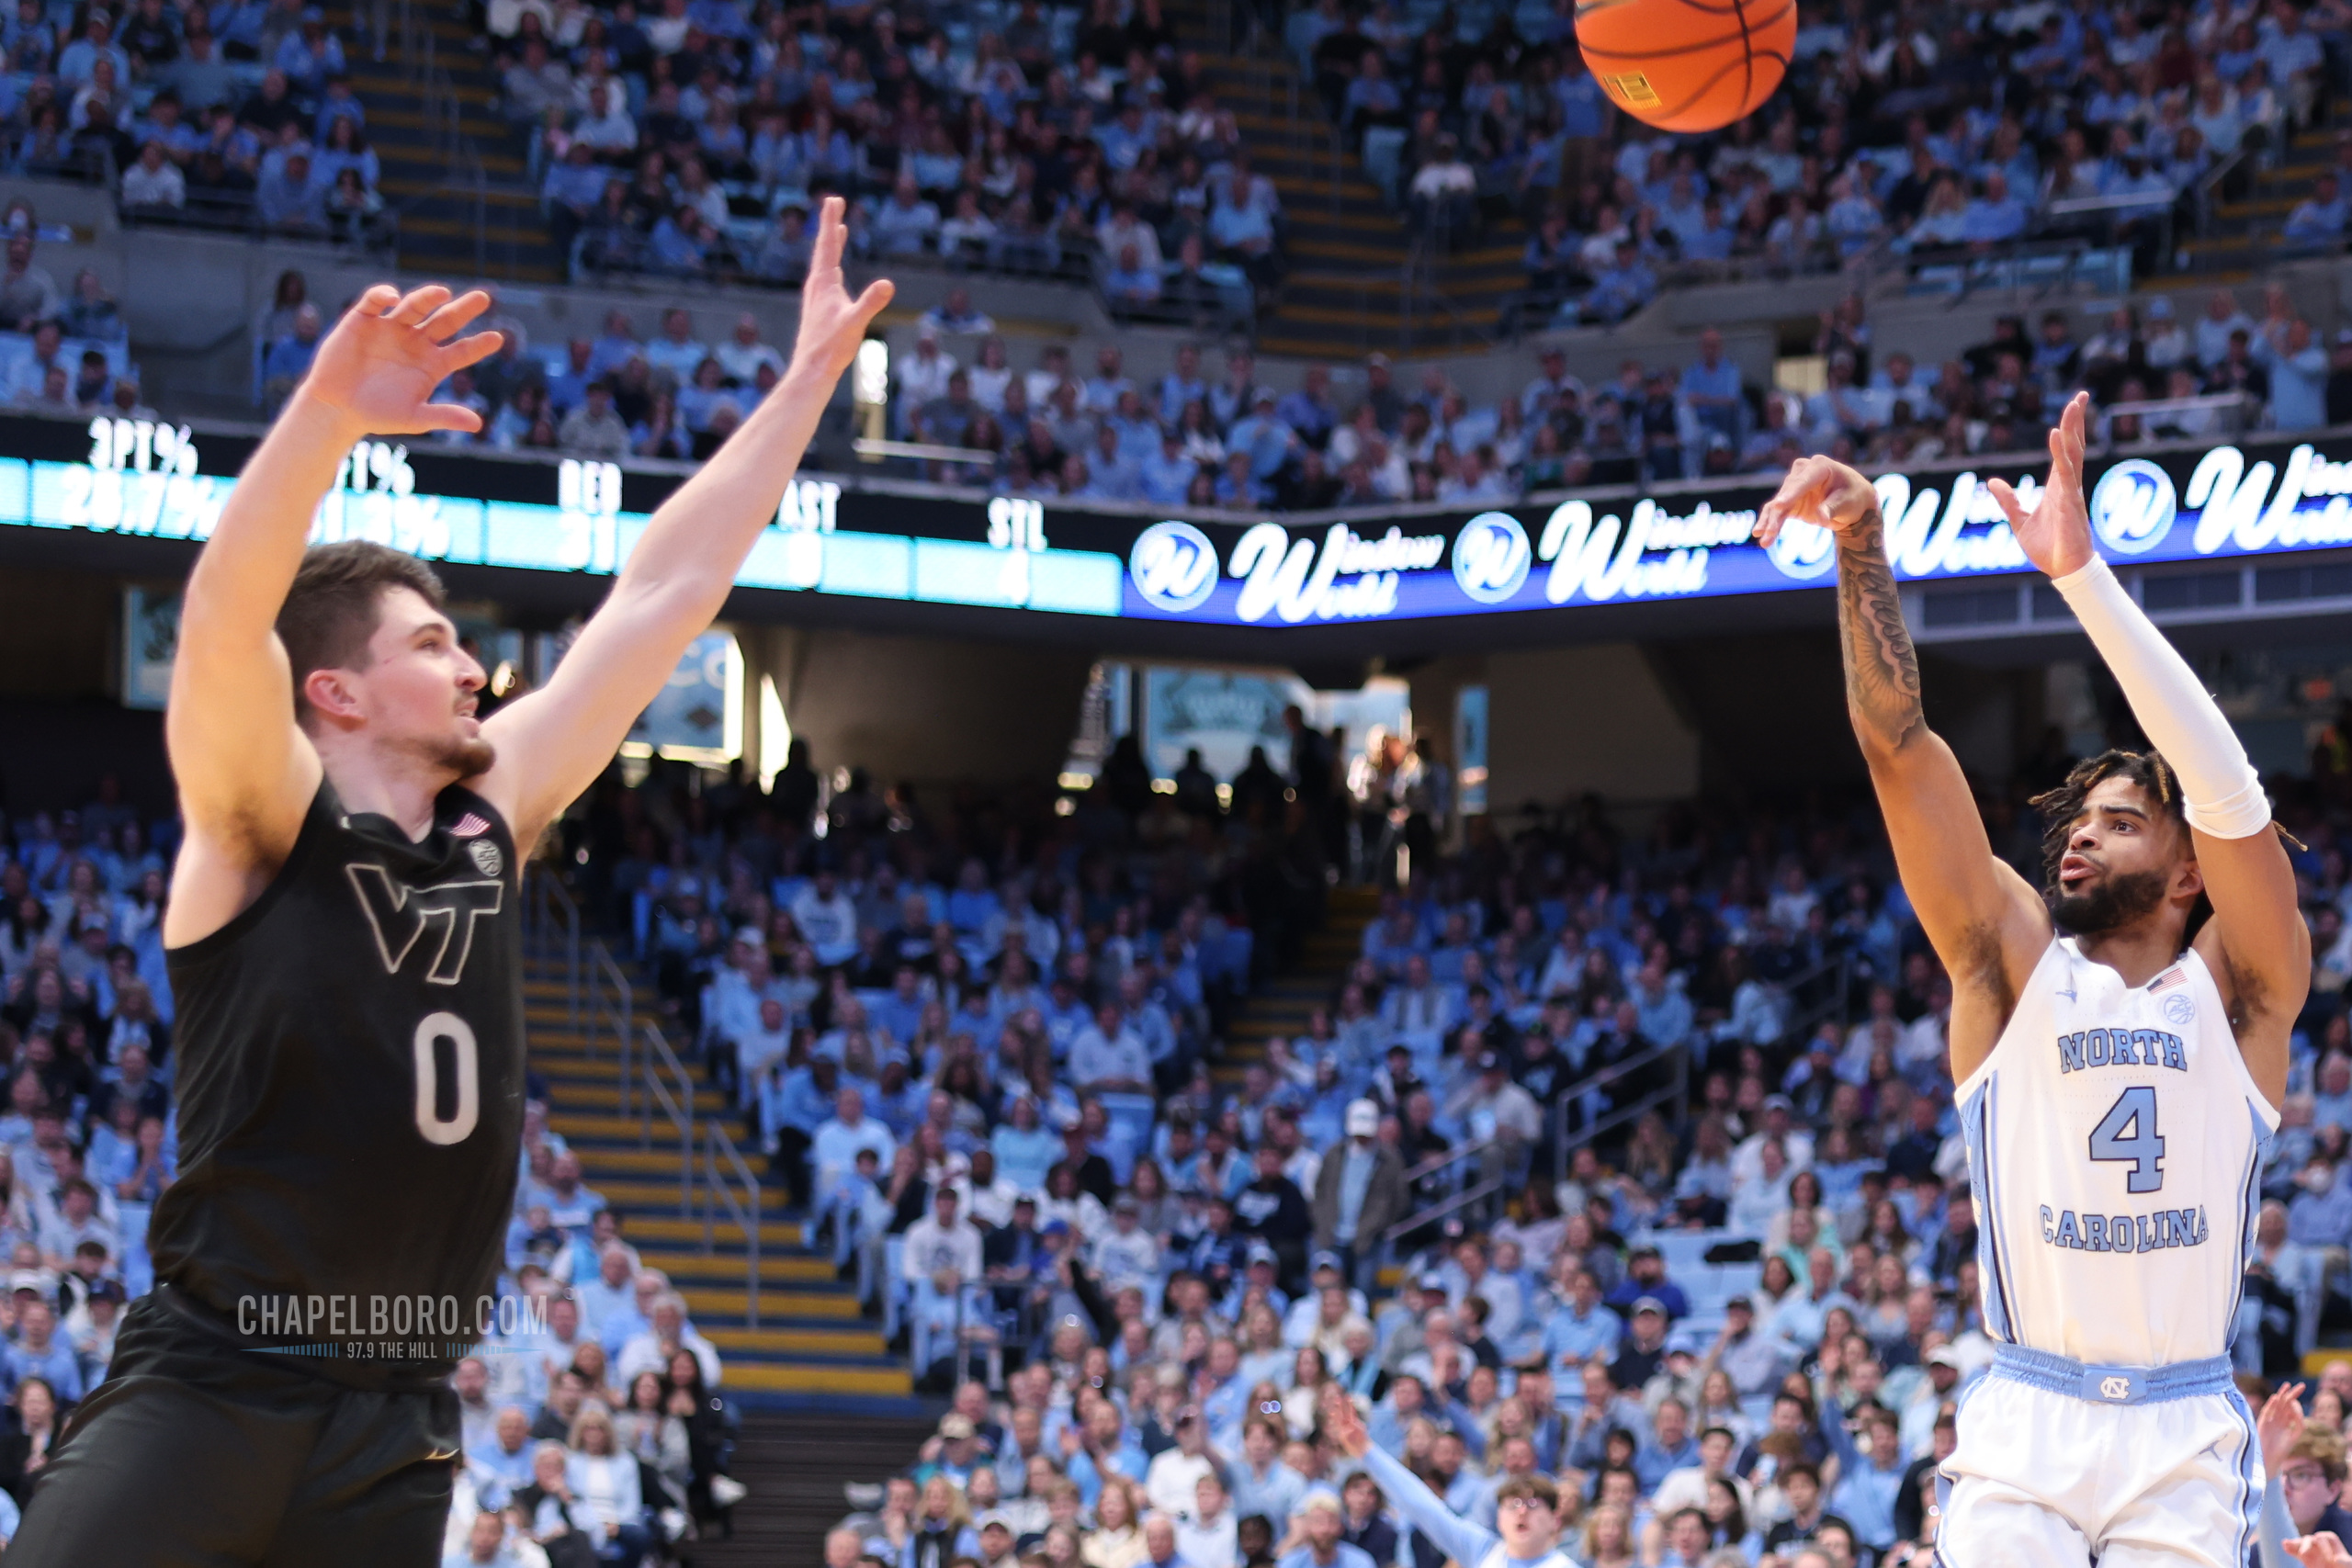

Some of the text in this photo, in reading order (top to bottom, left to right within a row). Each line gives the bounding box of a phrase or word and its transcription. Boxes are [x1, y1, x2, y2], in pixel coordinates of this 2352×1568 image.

[90, 417, 198, 477] 3PT%
[779, 479, 840, 535] AST
[989, 497, 1046, 553] STL
[345, 863, 503, 985] VT
[413, 1011, 480, 1145] 0
[2058, 1028, 2188, 1074] NORTH
[2088, 1086, 2165, 1194] 4
[2039, 1203, 2209, 1253] CAROLINA
